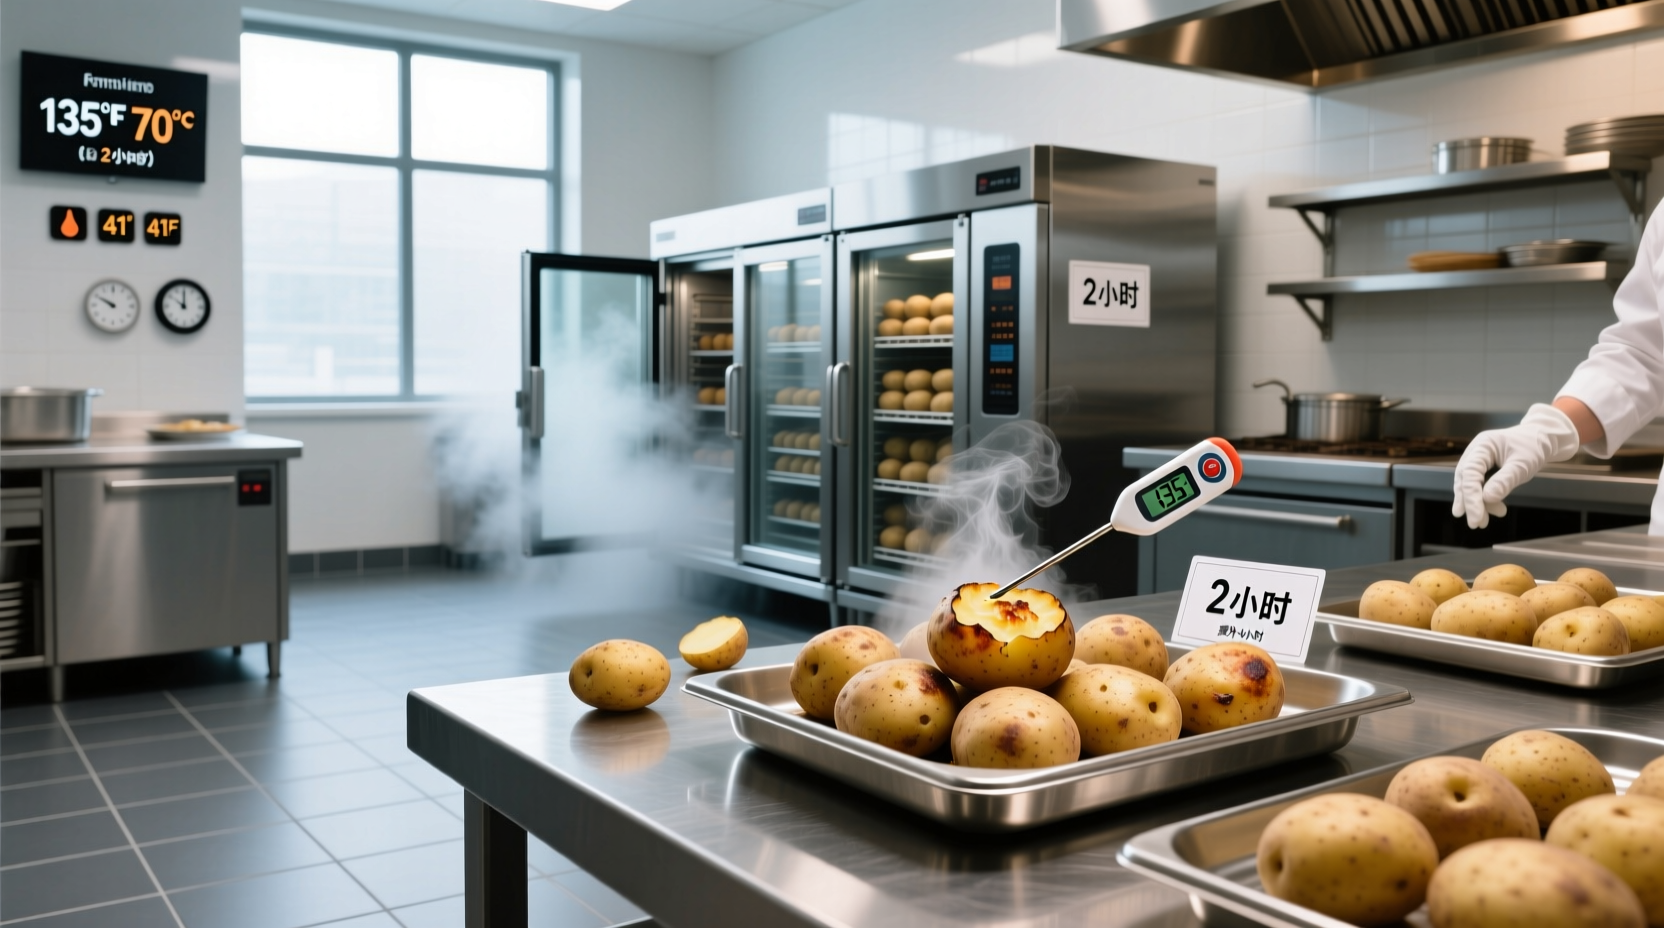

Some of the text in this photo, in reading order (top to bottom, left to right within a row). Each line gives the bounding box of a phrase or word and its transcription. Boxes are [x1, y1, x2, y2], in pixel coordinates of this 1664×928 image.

[40, 97, 195, 144] 135°F 70°C
[1083, 277, 1139, 309] 2小时
[1205, 578, 1293, 625] 2小时
